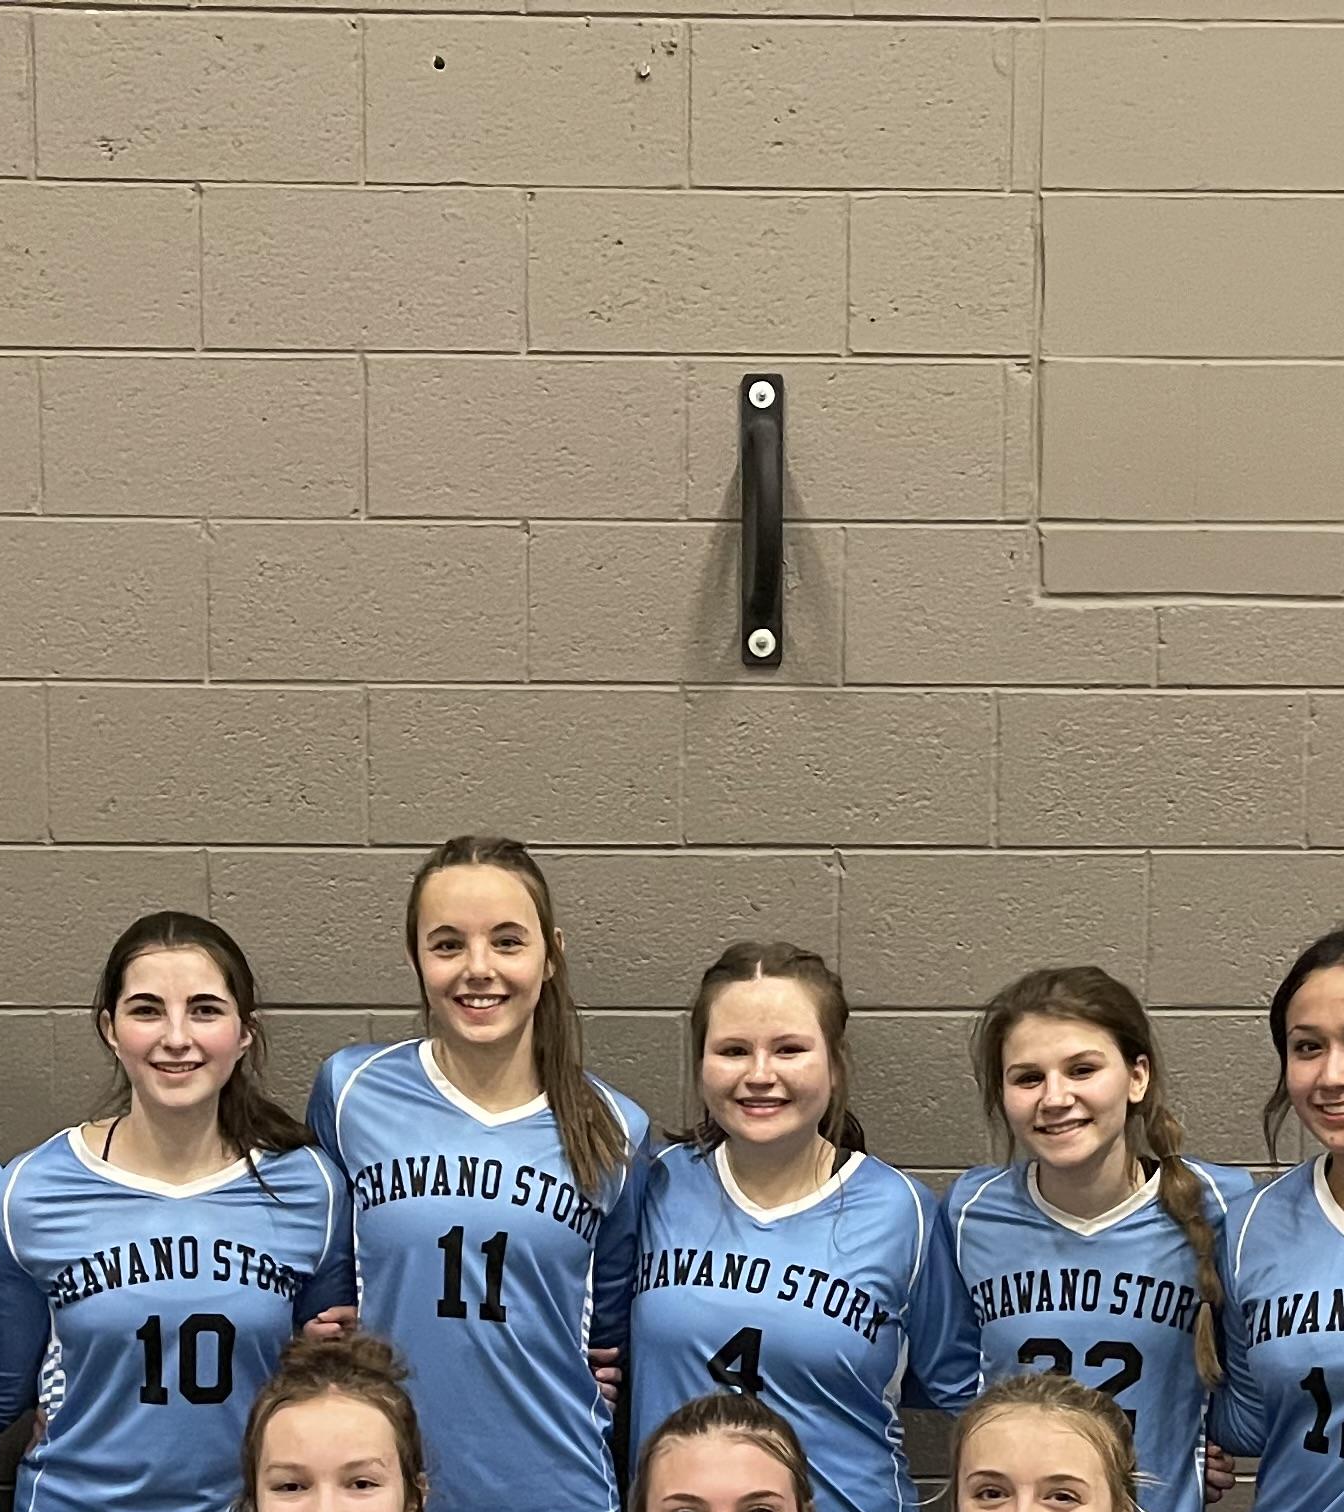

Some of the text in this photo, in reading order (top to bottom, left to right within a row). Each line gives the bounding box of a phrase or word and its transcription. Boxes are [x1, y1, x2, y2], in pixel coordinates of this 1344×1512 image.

[436, 1225, 509, 1323] 11
[636, 1248, 771, 1295] HAWANO
[1109, 1271, 1200, 1334] STOR
[135, 1313, 237, 1406] 10
[707, 1326, 764, 1396] 4
